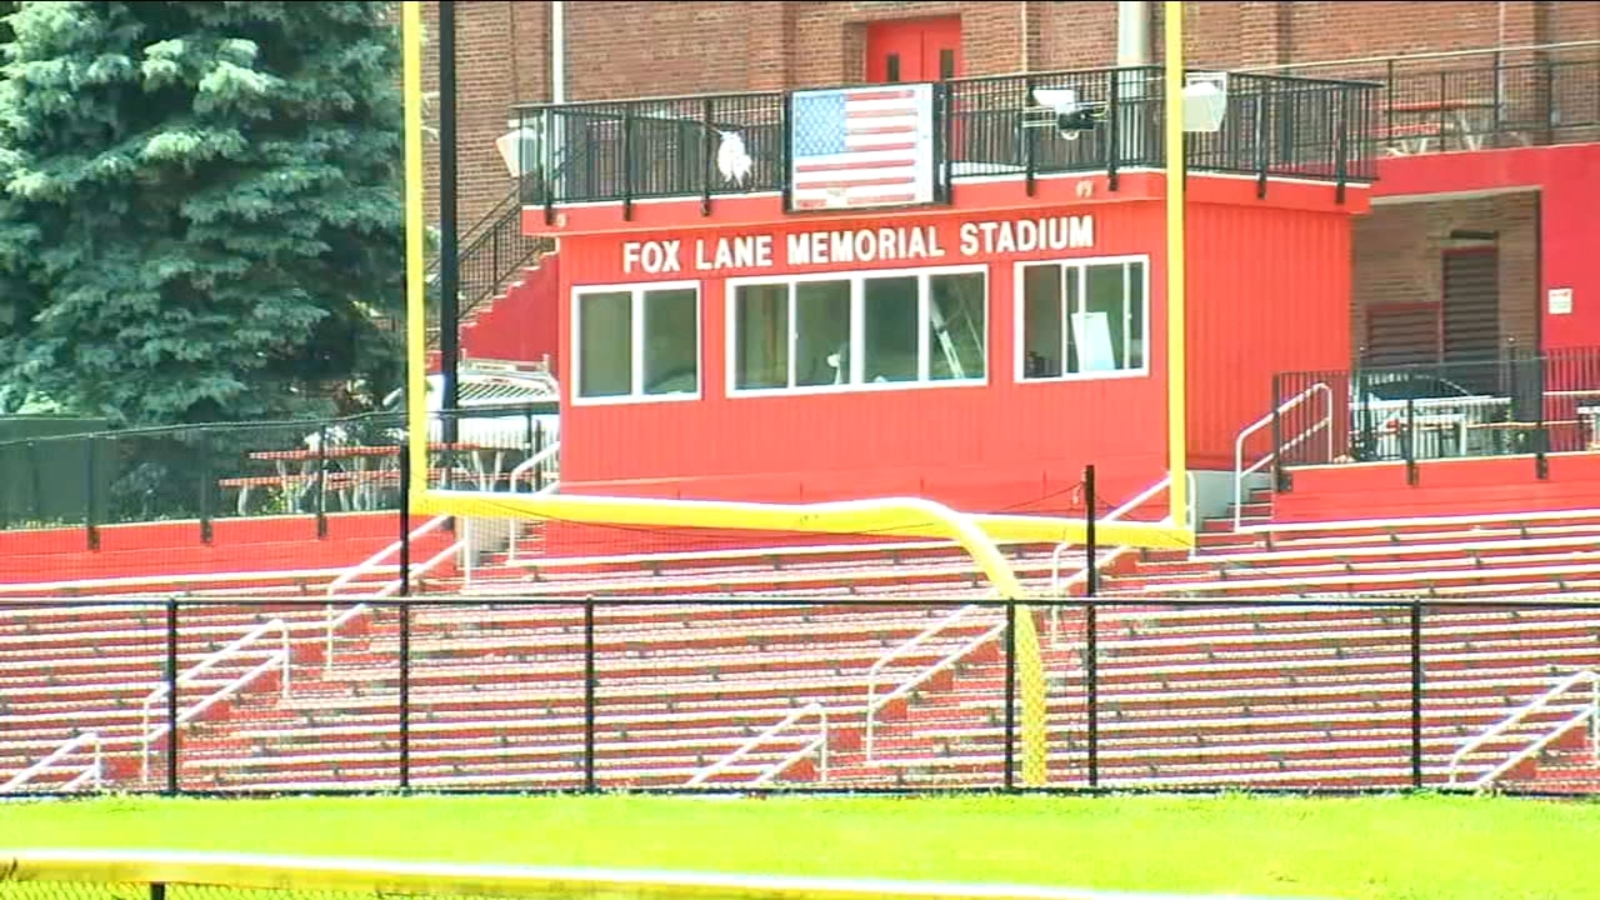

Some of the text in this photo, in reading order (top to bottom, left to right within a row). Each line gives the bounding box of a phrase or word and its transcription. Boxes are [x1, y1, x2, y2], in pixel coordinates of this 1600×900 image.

[623, 215, 1094, 274] FOX LANE MEMORIAL STADIUM
